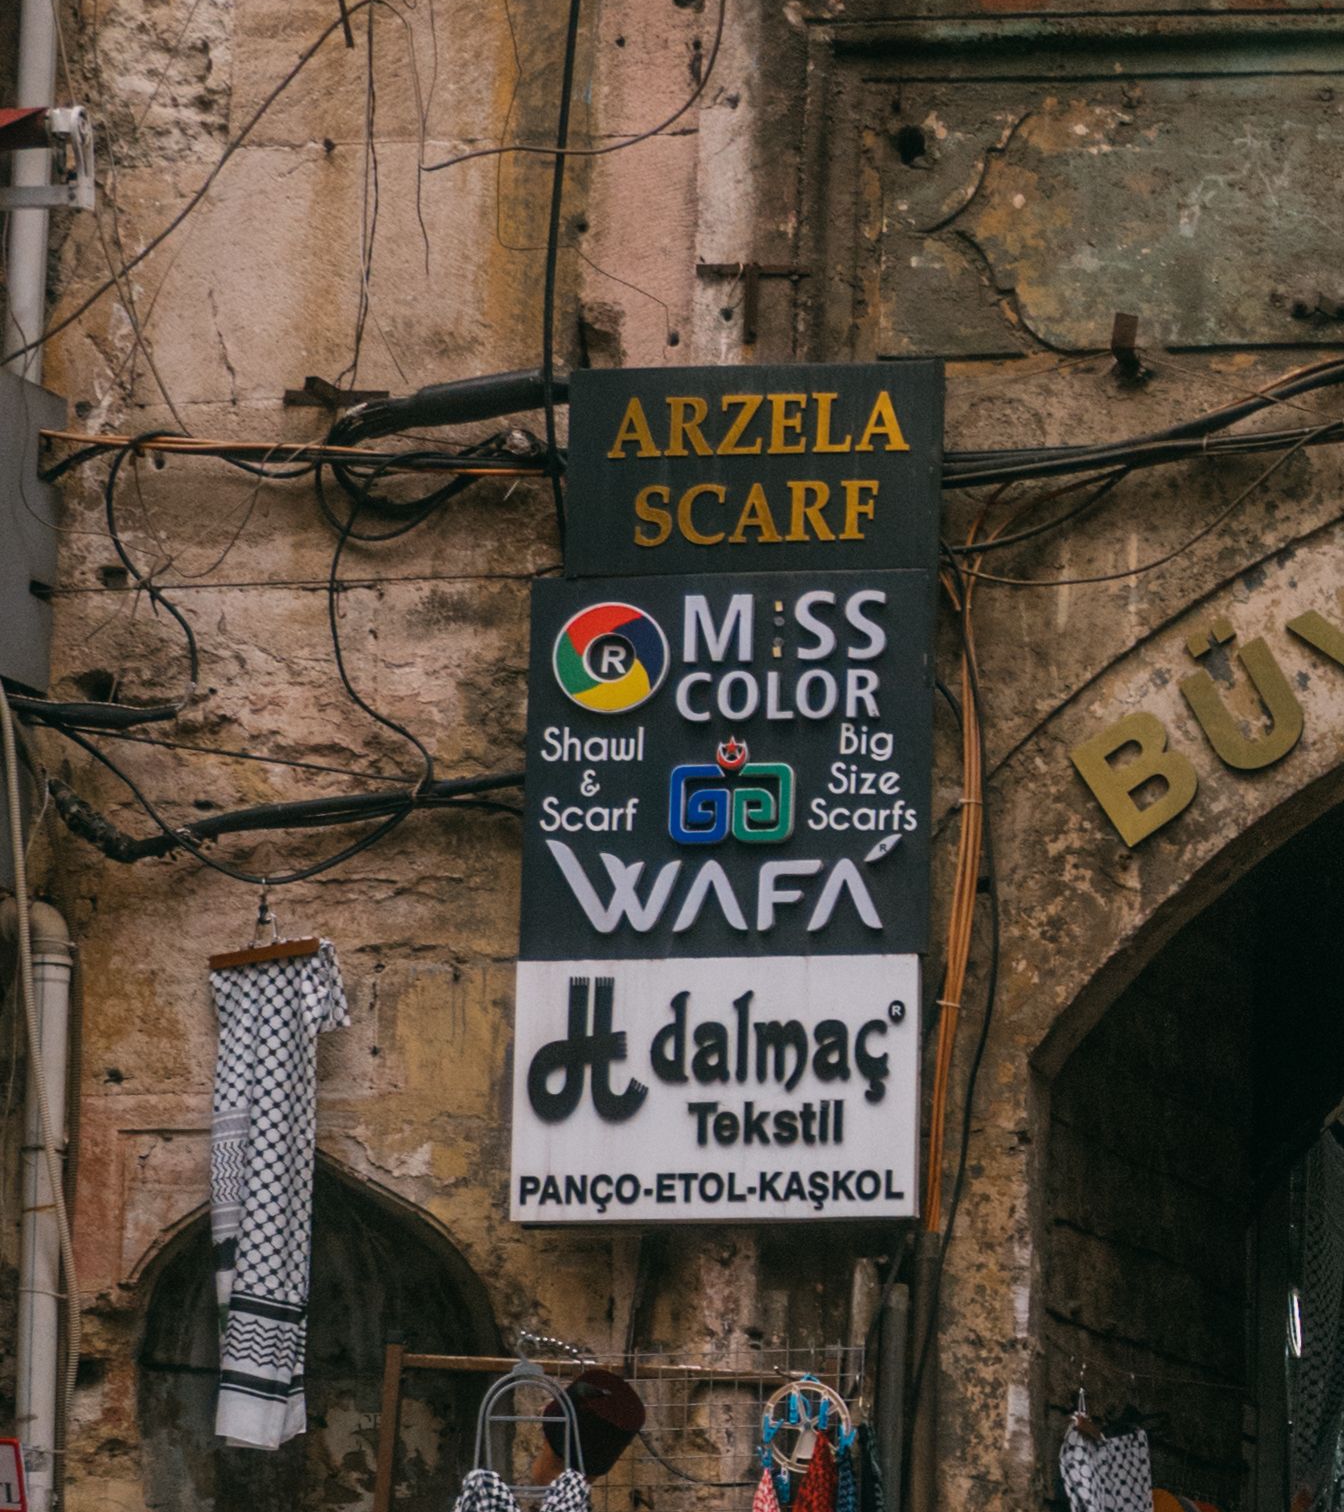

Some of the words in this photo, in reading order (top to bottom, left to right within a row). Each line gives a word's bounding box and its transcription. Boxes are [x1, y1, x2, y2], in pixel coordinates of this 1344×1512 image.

[608, 390, 910, 460] ARZELA
[633, 479, 880, 547] SCARF
[681, 589, 887, 663] MSS
[675, 668, 881, 724] COLOR
[540, 727, 645, 765] Shawl
[840, 722, 895, 762] Big
[580, 770, 601, 796] &
[829, 762, 902, 797] Size
[540, 796, 639, 834] Scarf
[807, 798, 918, 834] Scarfs
[546, 839, 884, 934] WAFA
[649, 989, 892, 1104] dalmaç
[687, 1099, 844, 1149] Tekstil
[518, 1169, 905, 1217] PANÇO-ETOL-KAŞKOL
